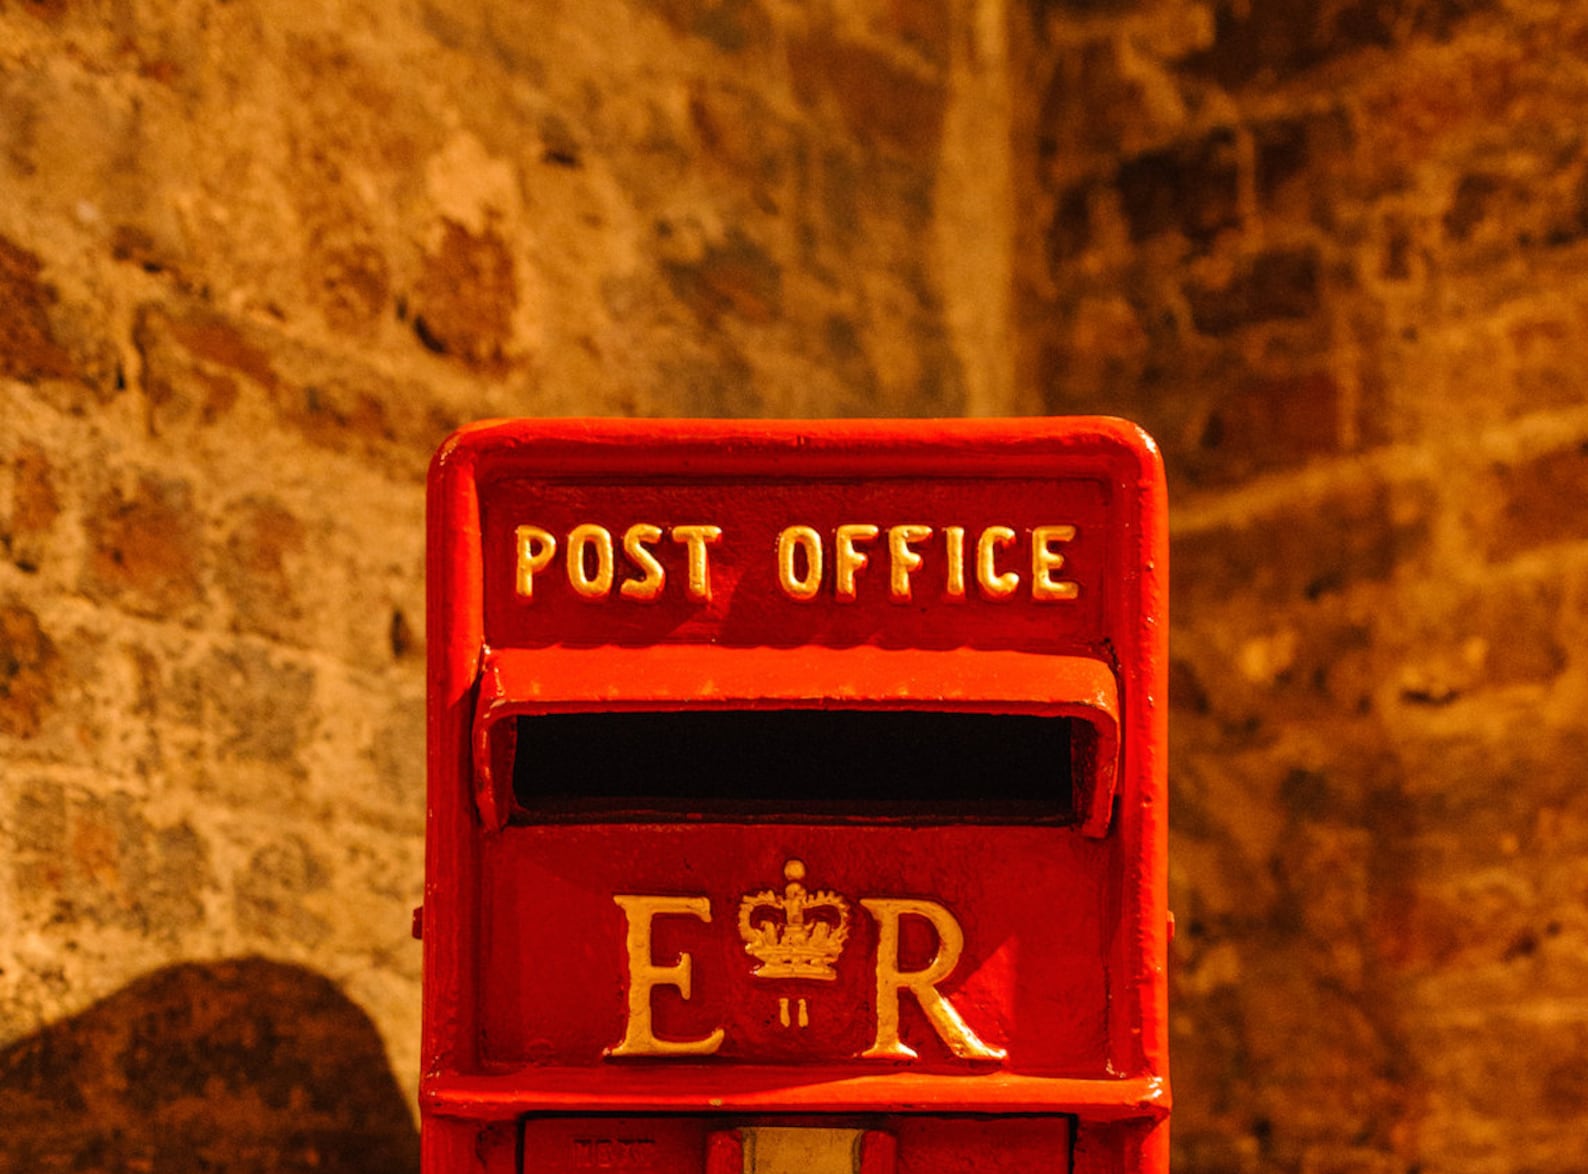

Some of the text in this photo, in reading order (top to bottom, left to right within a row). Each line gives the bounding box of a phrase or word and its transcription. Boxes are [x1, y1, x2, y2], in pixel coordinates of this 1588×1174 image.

[514, 524, 1079, 601] POST OFFICE
[603, 894, 1007, 1060] E R
